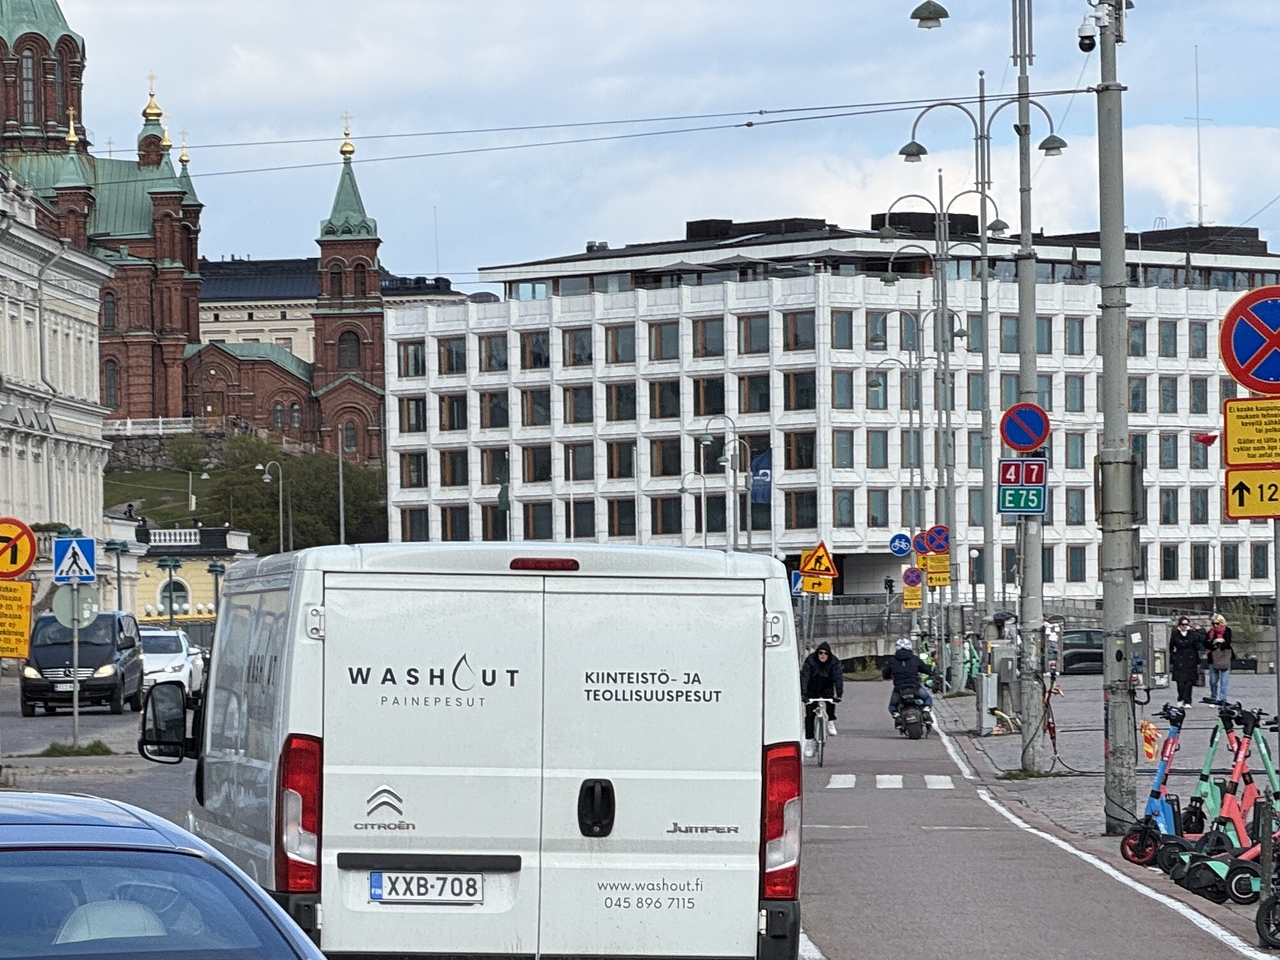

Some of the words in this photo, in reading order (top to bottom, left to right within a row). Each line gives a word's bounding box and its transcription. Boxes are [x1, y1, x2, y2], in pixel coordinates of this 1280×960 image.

[1005, 465, 1016, 482] 4
[1030, 465, 1039, 482] 7
[1005, 490, 1015, 507] E
[1019, 490, 1038, 507] 75
[1258, 483, 1279, 502] 12
[585, 669, 677, 684] KIINTEISTÖ-
[683, 672, 702, 685] JA
[381, 696, 485, 707] PAINEPESUT
[584, 689, 722, 703] TEOLLISUUSPESUT
[387, 876, 478, 897] XXB-708
[597, 877, 703, 892] www.washout.fi
[604, 897, 631, 909] 045
[636, 897, 662, 909] 896
[667, 897, 695, 909] 7115
